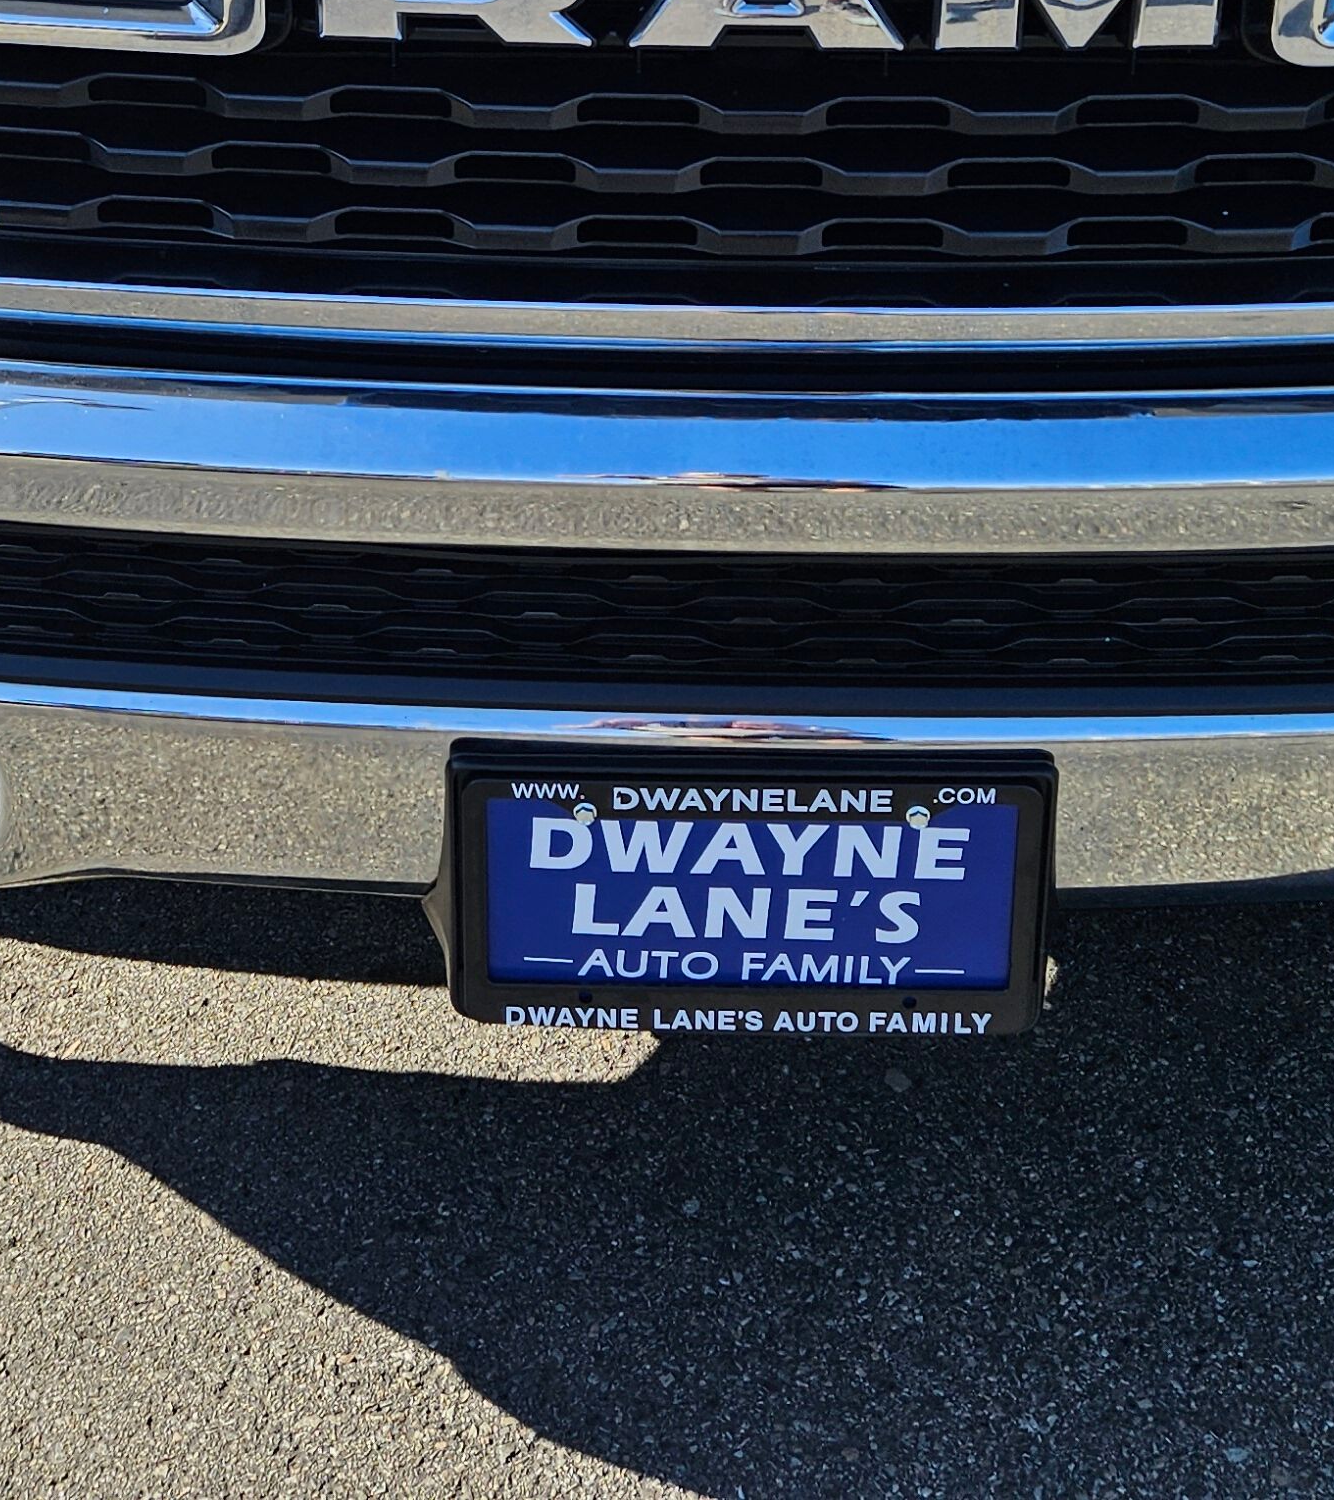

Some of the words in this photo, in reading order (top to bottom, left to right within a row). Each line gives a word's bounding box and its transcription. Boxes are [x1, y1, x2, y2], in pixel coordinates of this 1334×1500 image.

[612, 786, 894, 814] DWAYNELANE
[933, 787, 997, 805] .COM
[529, 816, 971, 881] DWAYNE
[571, 882, 922, 945] LANE'S
[577, 948, 720, 981] AUTO
[741, 951, 912, 985] FAMILY
[504, 1005, 639, 1031] DWAYNE
[653, 1008, 765, 1033] LANE'S
[773, 1010, 860, 1034] AUTO
[868, 1011, 993, 1036] FAMILY
